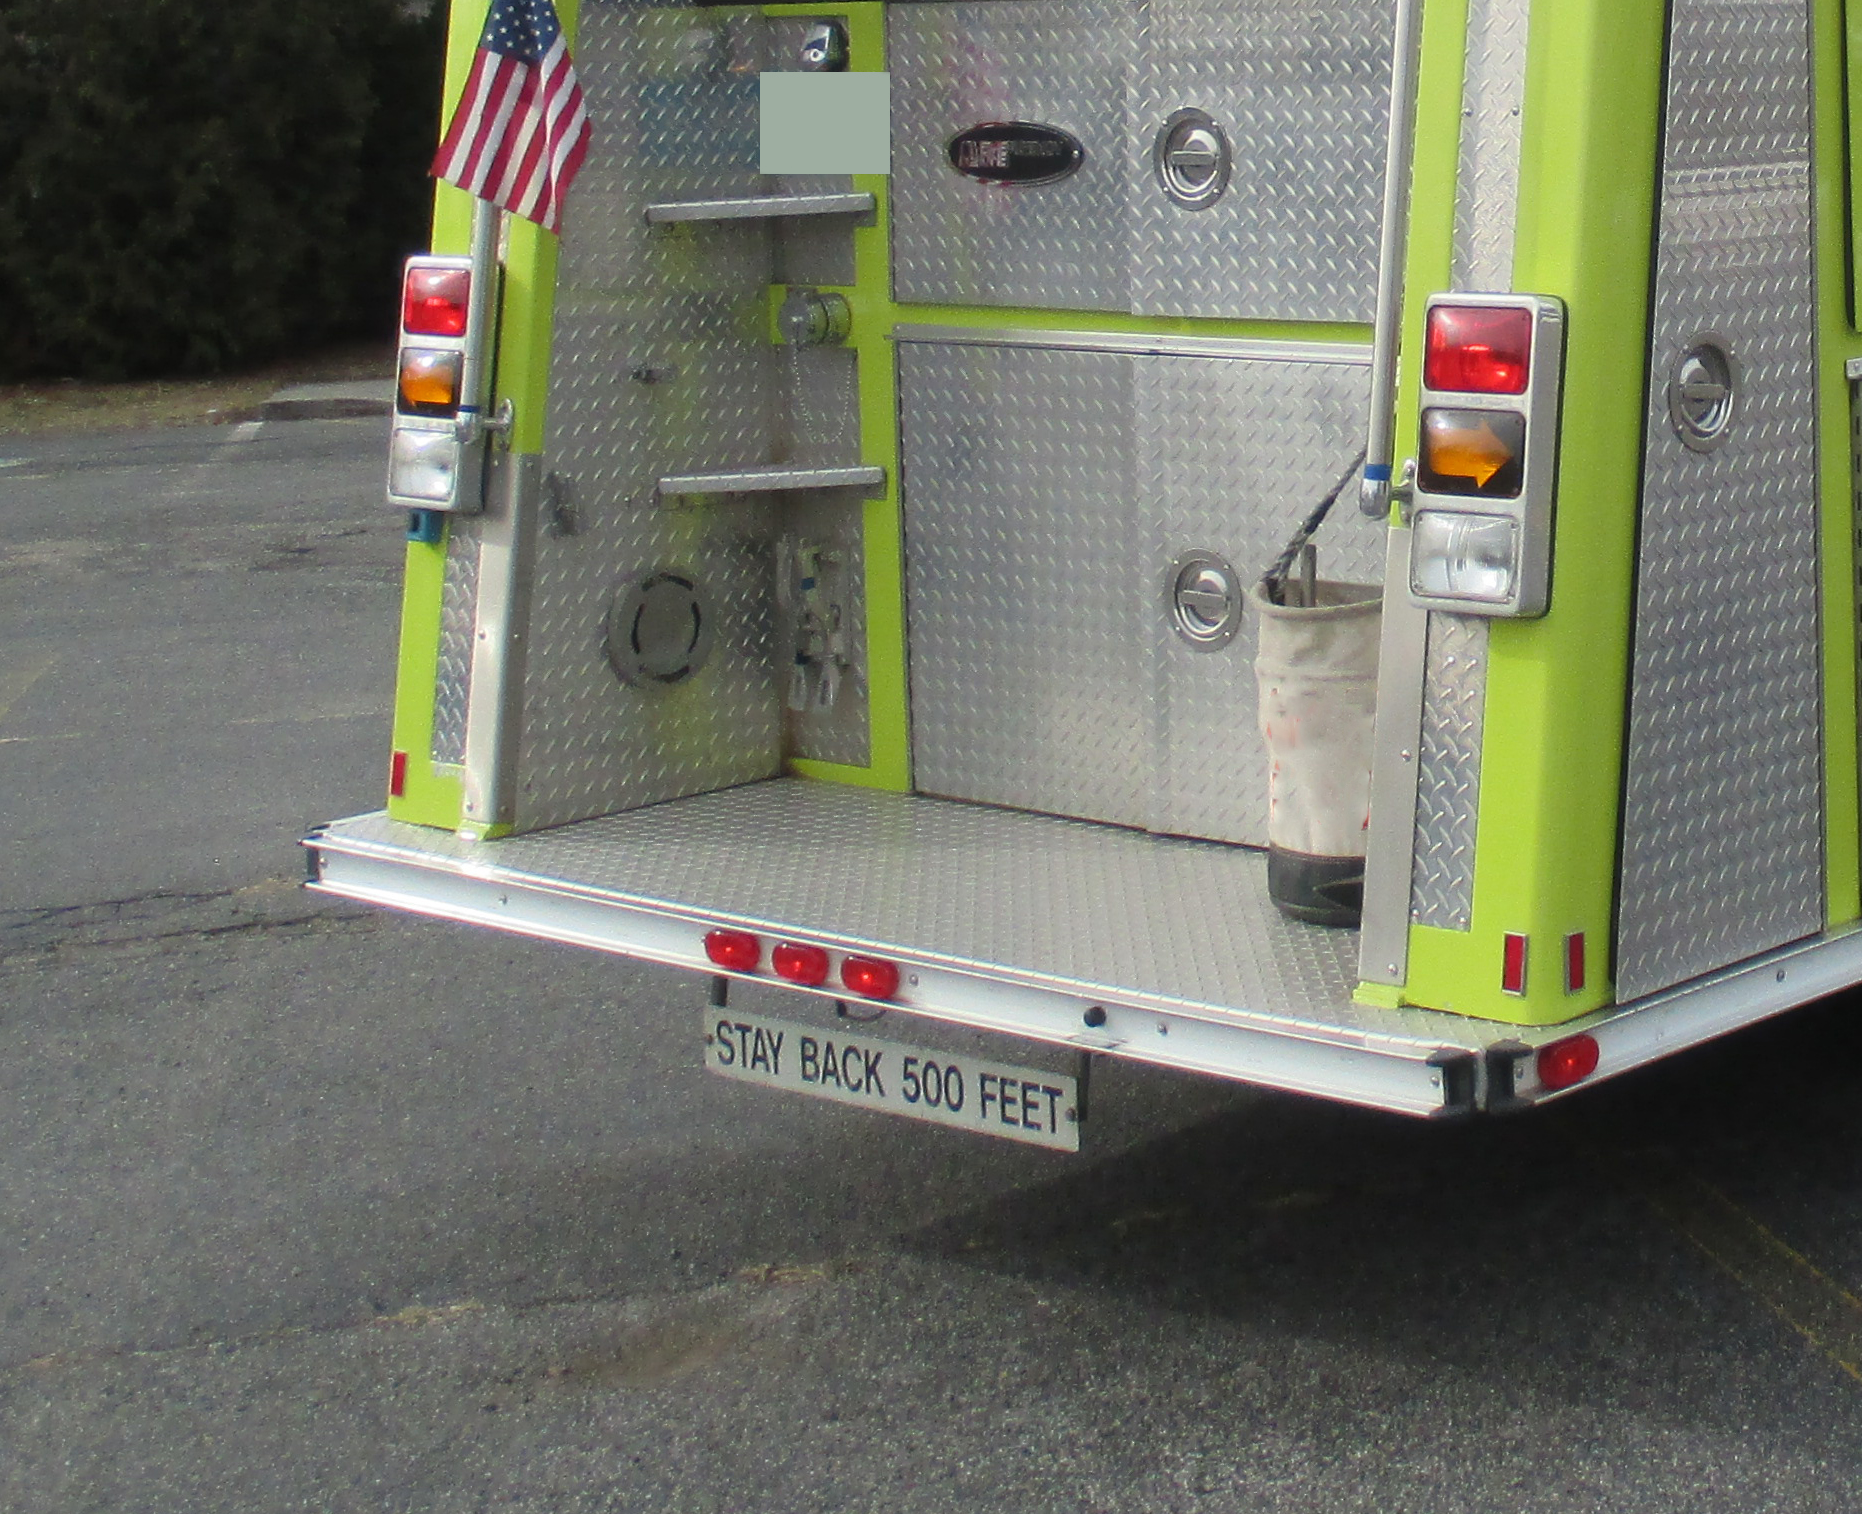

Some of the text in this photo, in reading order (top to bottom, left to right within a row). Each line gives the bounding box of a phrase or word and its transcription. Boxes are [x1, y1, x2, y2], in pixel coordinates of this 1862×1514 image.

[715, 1019, 1064, 1134] STAY BACK 500 FEET
